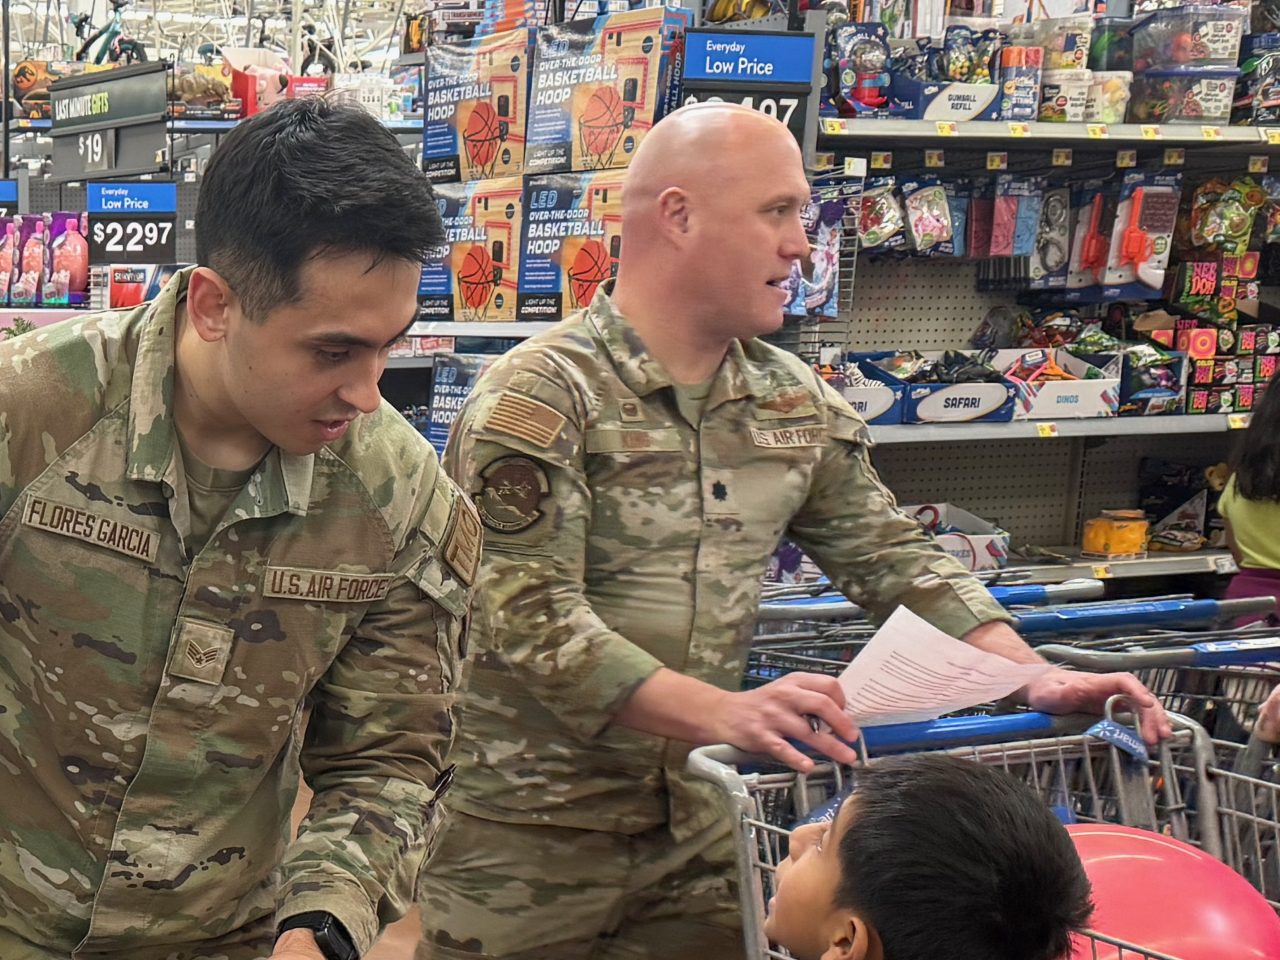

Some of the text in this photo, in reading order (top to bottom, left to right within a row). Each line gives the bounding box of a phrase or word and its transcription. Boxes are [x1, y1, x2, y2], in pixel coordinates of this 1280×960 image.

[706, 40, 745, 55] Everyday
[539, 54, 602, 71] OVER-THE-DOOR
[705, 56, 774, 75] Low Price
[428, 73, 478, 90] OVER-THE-DOOR
[537, 65, 617, 88] BASKETBALL
[427, 83, 491, 106] BASKETBALL
[536, 88, 571, 105] HOOP
[55, 91, 109, 120] LAST MINUTE GIFTS
[427, 105, 455, 121] HOOP
[78, 133, 103, 163] $19
[101, 188, 129, 198] Everyday
[530, 190, 558, 209] LED
[101, 199, 149, 209] Low Price
[529, 208, 590, 221] OVER-THE-DOOR
[527, 221, 605, 238] BASKETBALL
[526, 240, 560, 254] HOOP
[432, 395, 465, 410] BASKE
[943, 396, 981, 409] SAFARI
[1056, 395, 1079, 403] DINOS
[772, 429, 793, 446] AIR
[27, 499, 151, 559] FLORES GARCIA
[335, 576, 388, 600] FORCE
